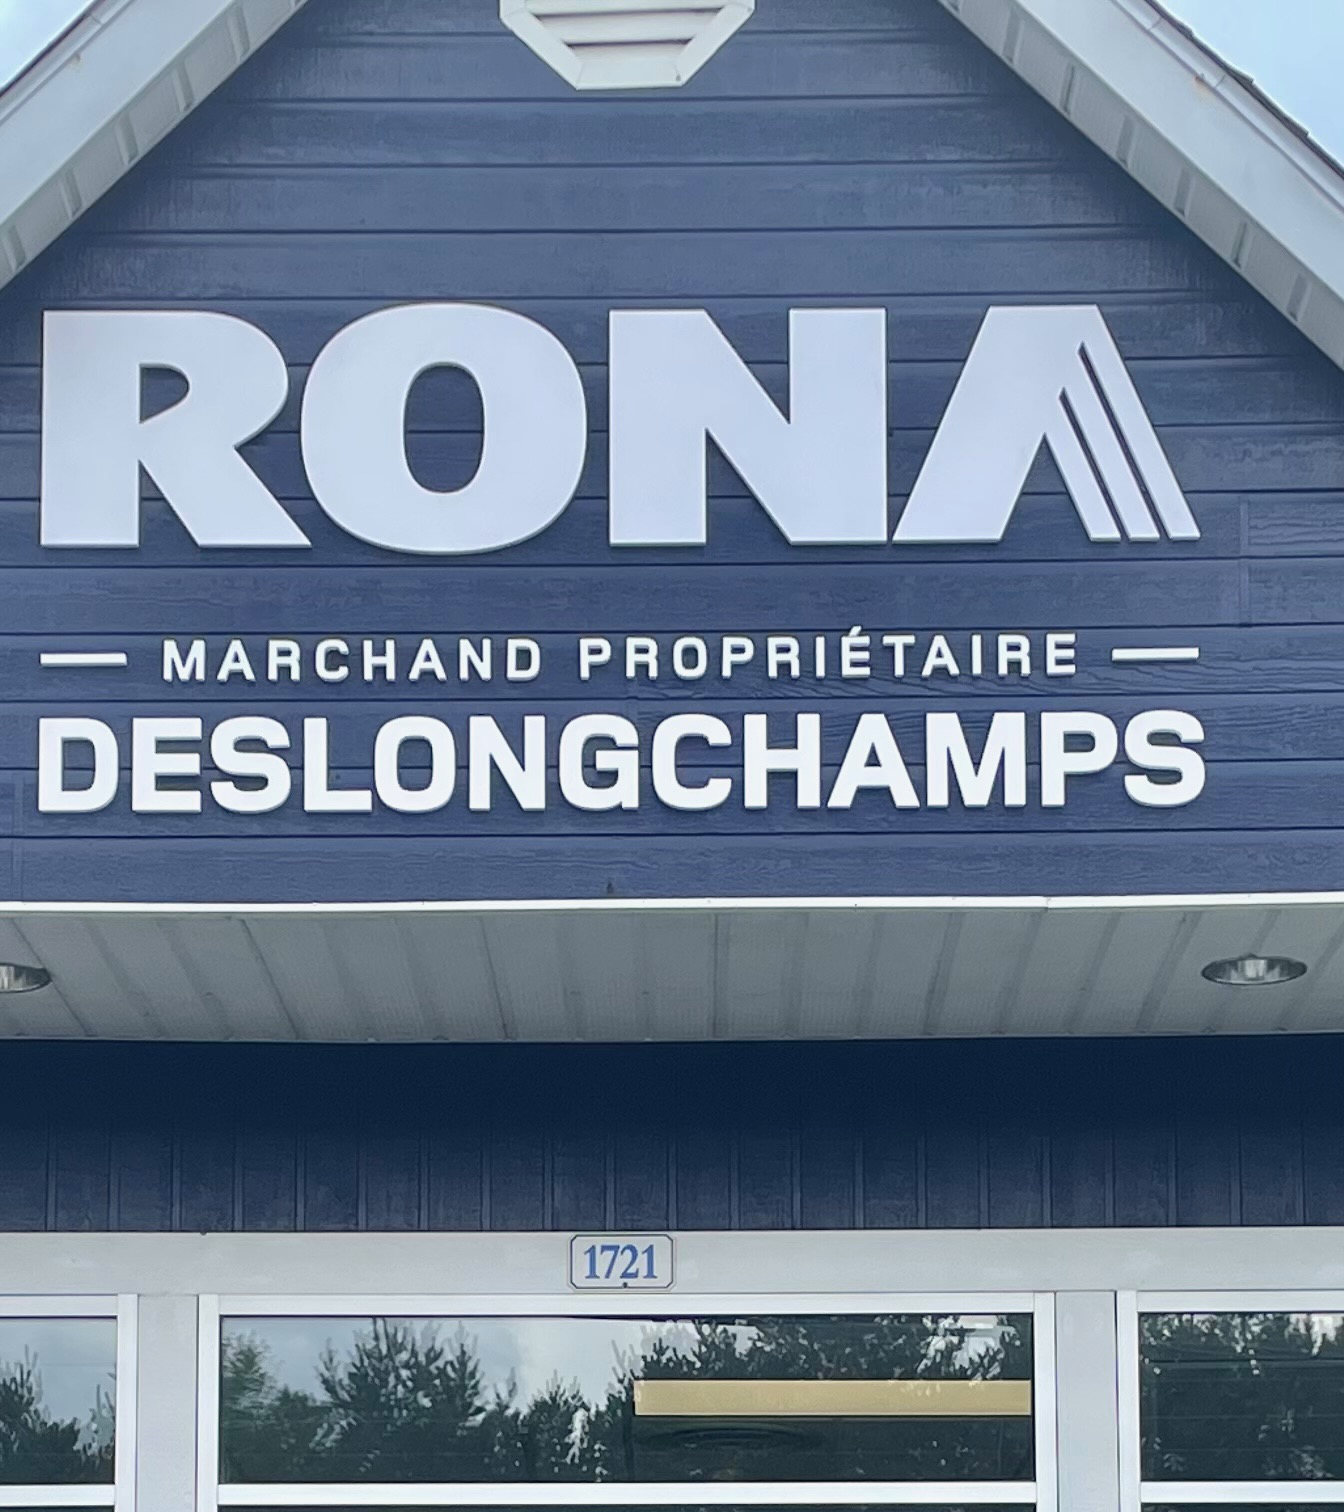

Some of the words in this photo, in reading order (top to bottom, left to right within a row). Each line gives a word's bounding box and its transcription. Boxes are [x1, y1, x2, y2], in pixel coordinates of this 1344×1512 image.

[40, 301, 1202, 557] RONA
[161, 636, 542, 682] MARCHAND
[577, 625, 1080, 679] PROPRIÉTAIRE
[36, 708, 1207, 815] DESLONGCHAMPS
[583, 1243, 658, 1281] 1721
